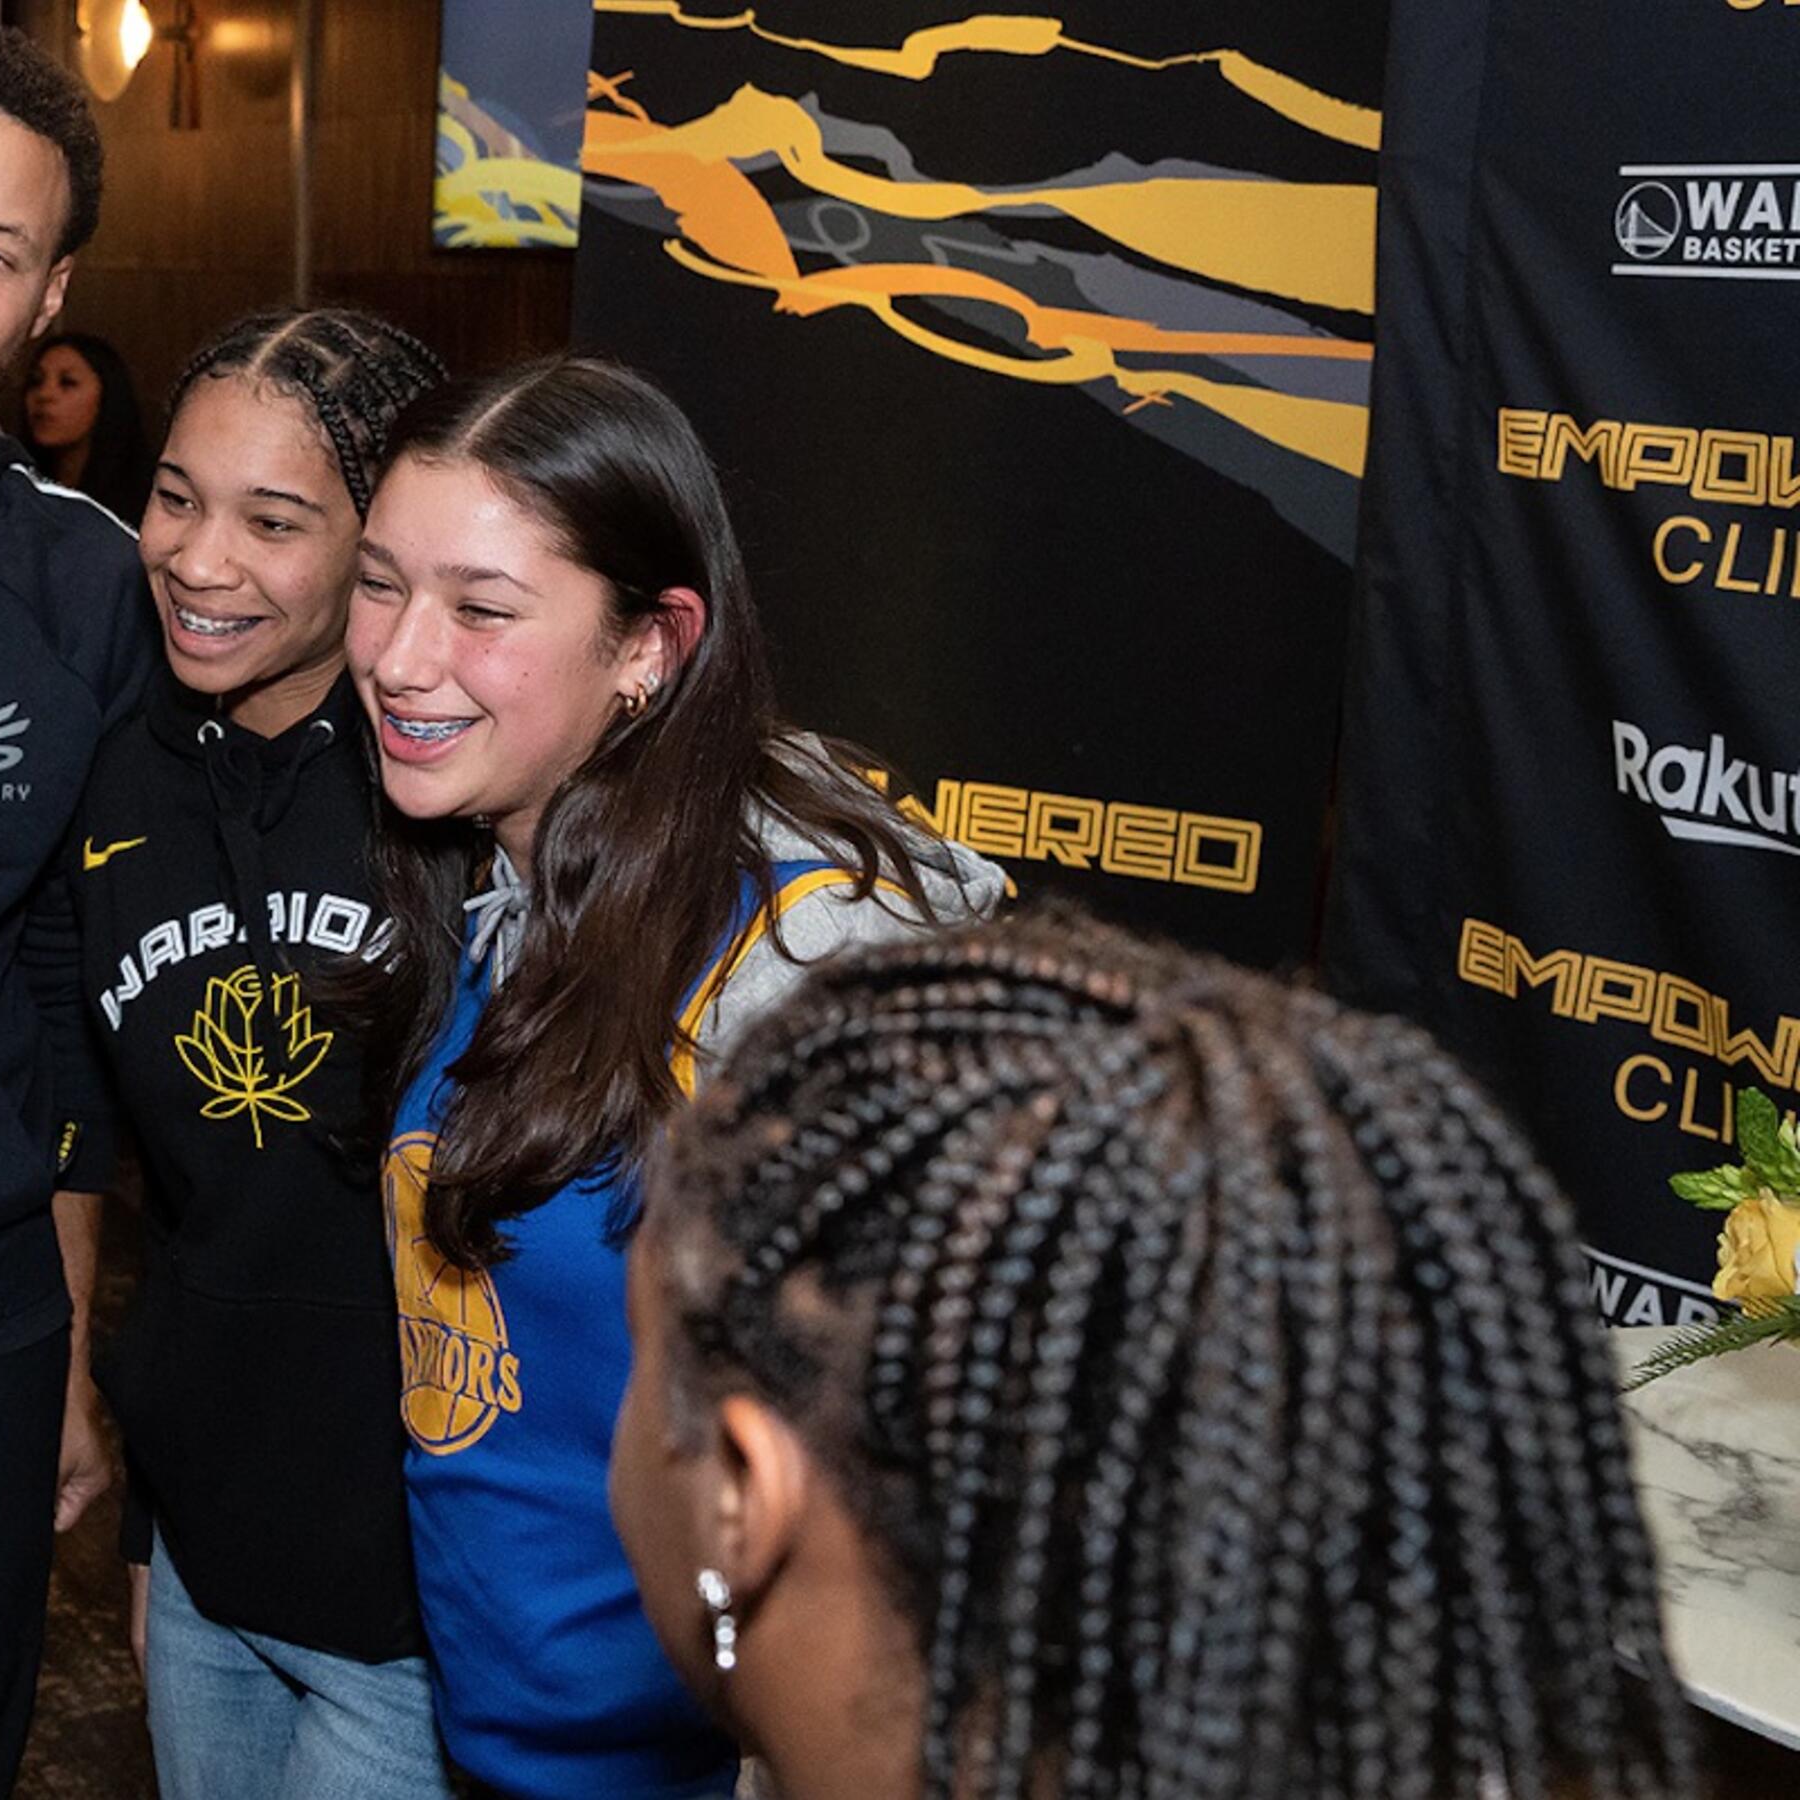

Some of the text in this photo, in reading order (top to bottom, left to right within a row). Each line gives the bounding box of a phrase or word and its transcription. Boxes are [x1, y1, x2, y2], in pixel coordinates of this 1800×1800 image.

[1685, 180, 1800, 231] WA
[1682, 235, 1800, 263] BASKET
[1653, 515, 1800, 598] CLI
[1458, 917, 1800, 1093] EMPOW
[1614, 1053, 1797, 1145] CLI
